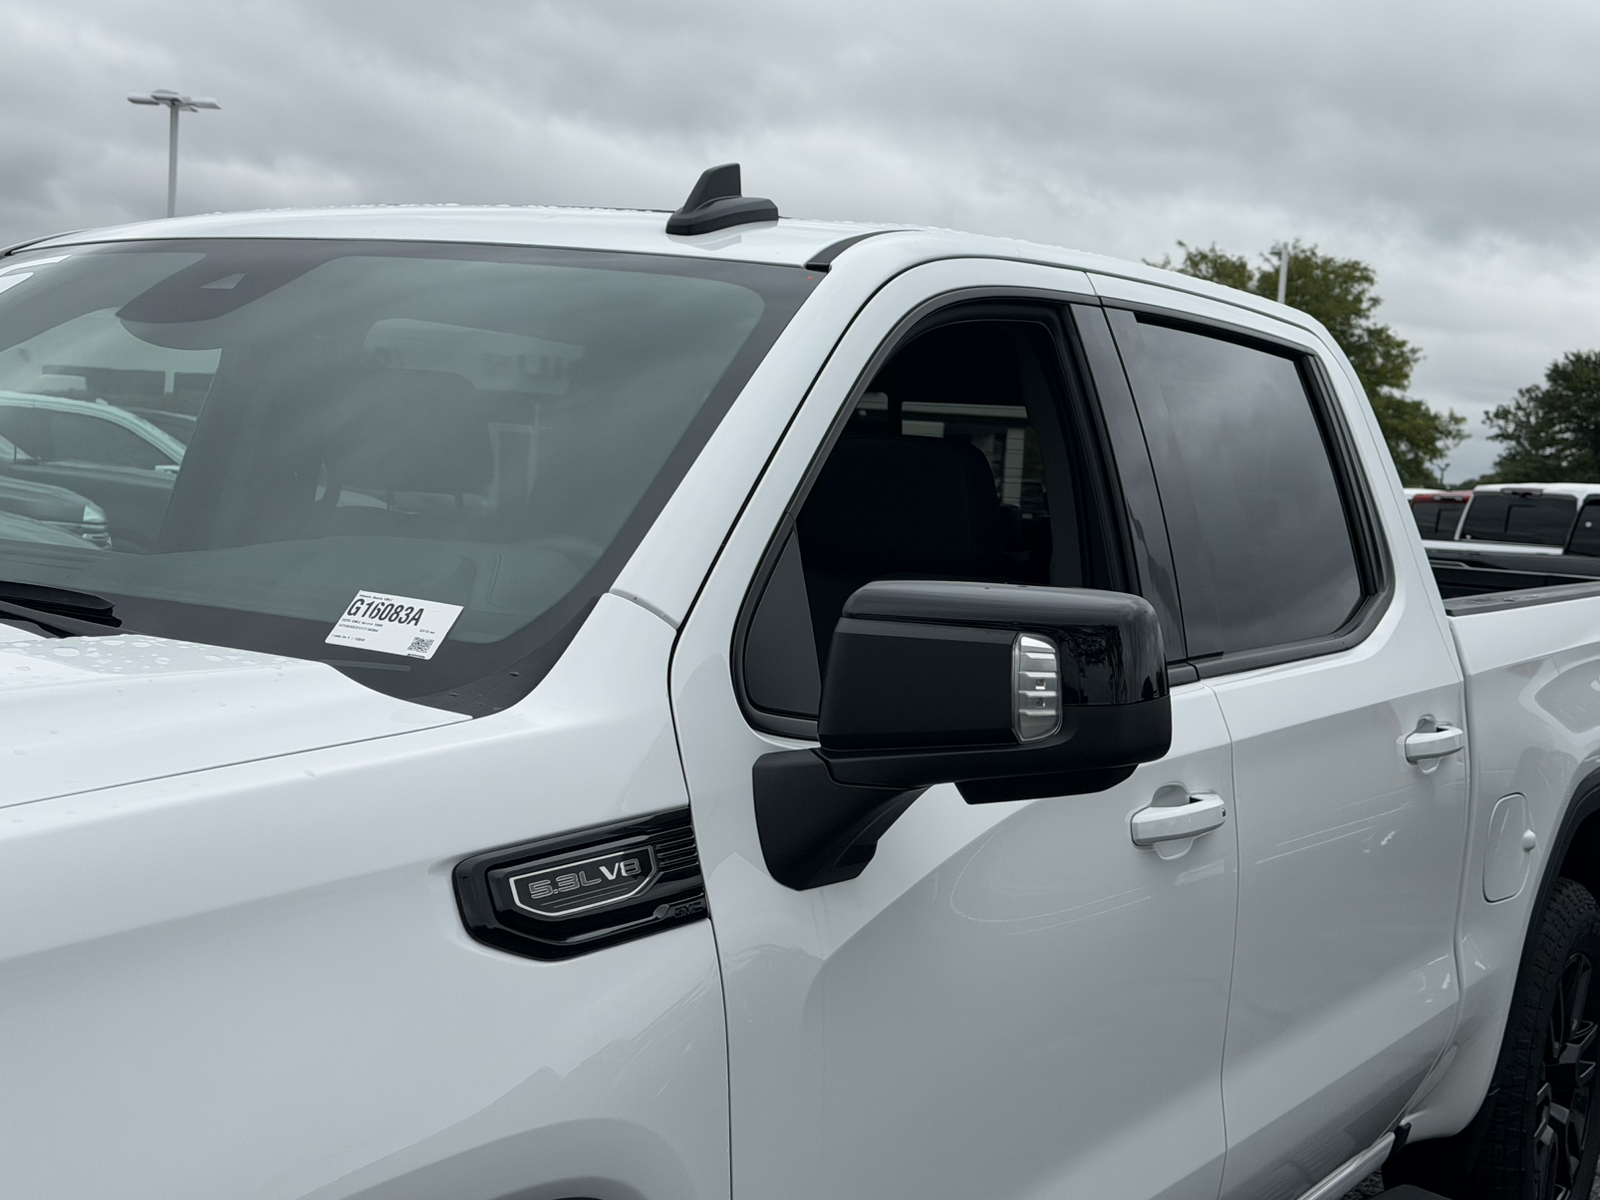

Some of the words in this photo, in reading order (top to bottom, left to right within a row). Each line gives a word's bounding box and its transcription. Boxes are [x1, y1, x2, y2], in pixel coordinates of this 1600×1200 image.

[347, 598, 425, 626] G16083A
[528, 870, 602, 899] 5.3L
[599, 858, 642, 881] V8
